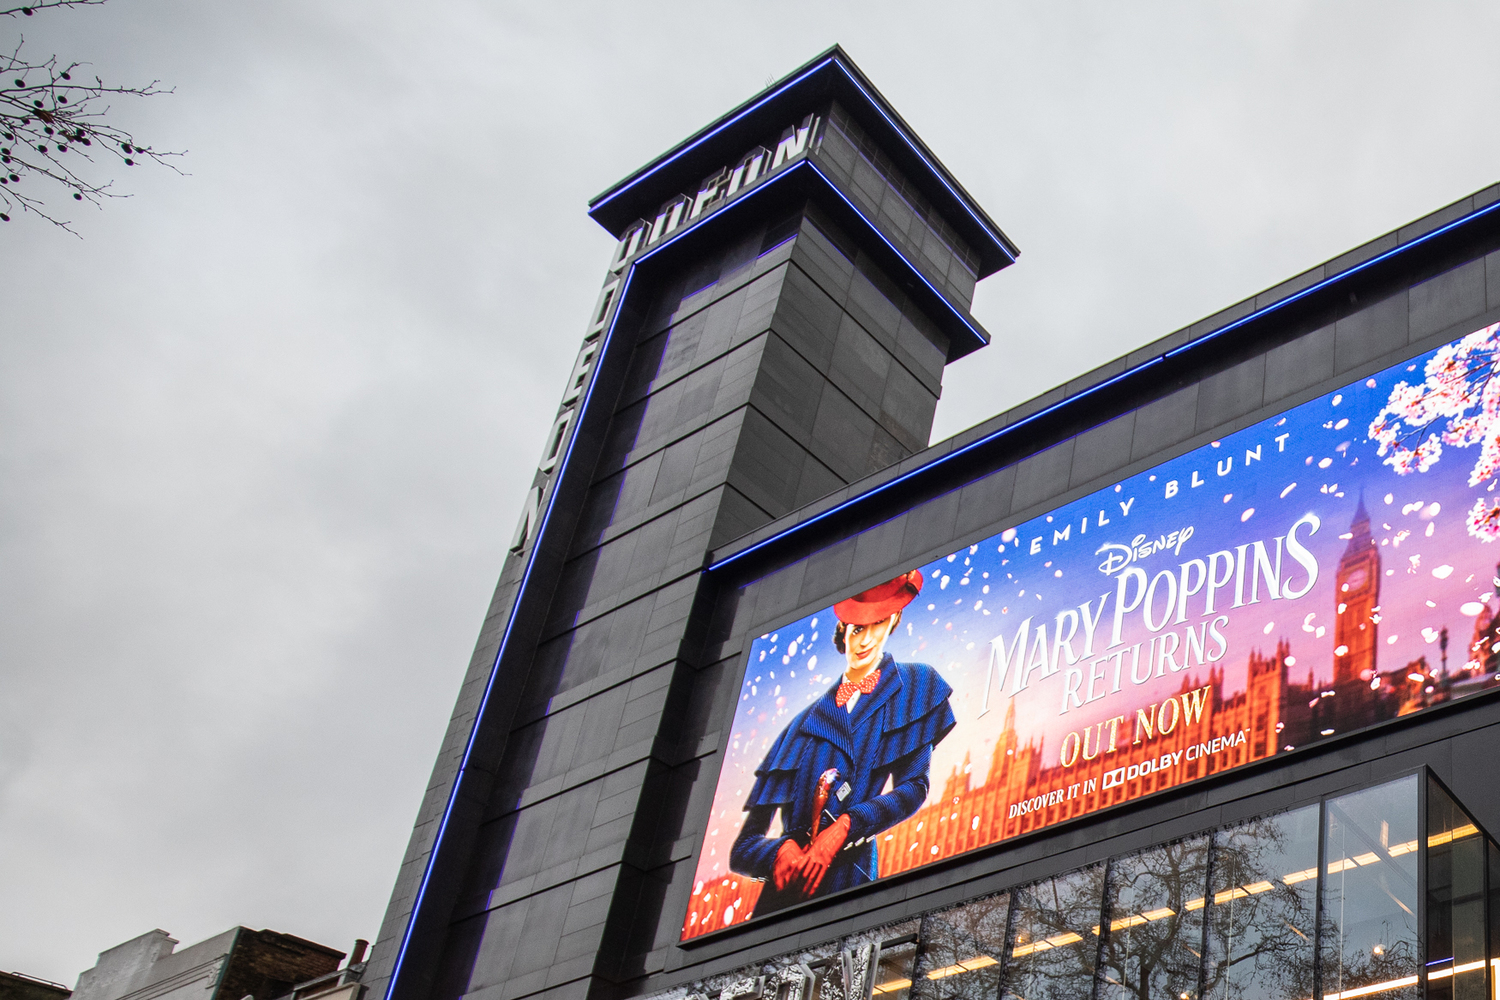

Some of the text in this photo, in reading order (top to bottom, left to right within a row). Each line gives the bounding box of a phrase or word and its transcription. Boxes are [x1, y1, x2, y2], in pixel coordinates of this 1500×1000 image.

[1030, 432, 1290, 555] EMILY BLUNT
[977, 513, 1322, 720] MARY POPPINS
[1059, 615, 1229, 715] RETURNS
[1060, 685, 1211, 768] OUT NOW
[1008, 788, 1064, 819] DISCOVER
[1067, 783, 1080, 800] IT
[1083, 778, 1097, 796] IN
[1126, 750, 1185, 781] DOLBY
